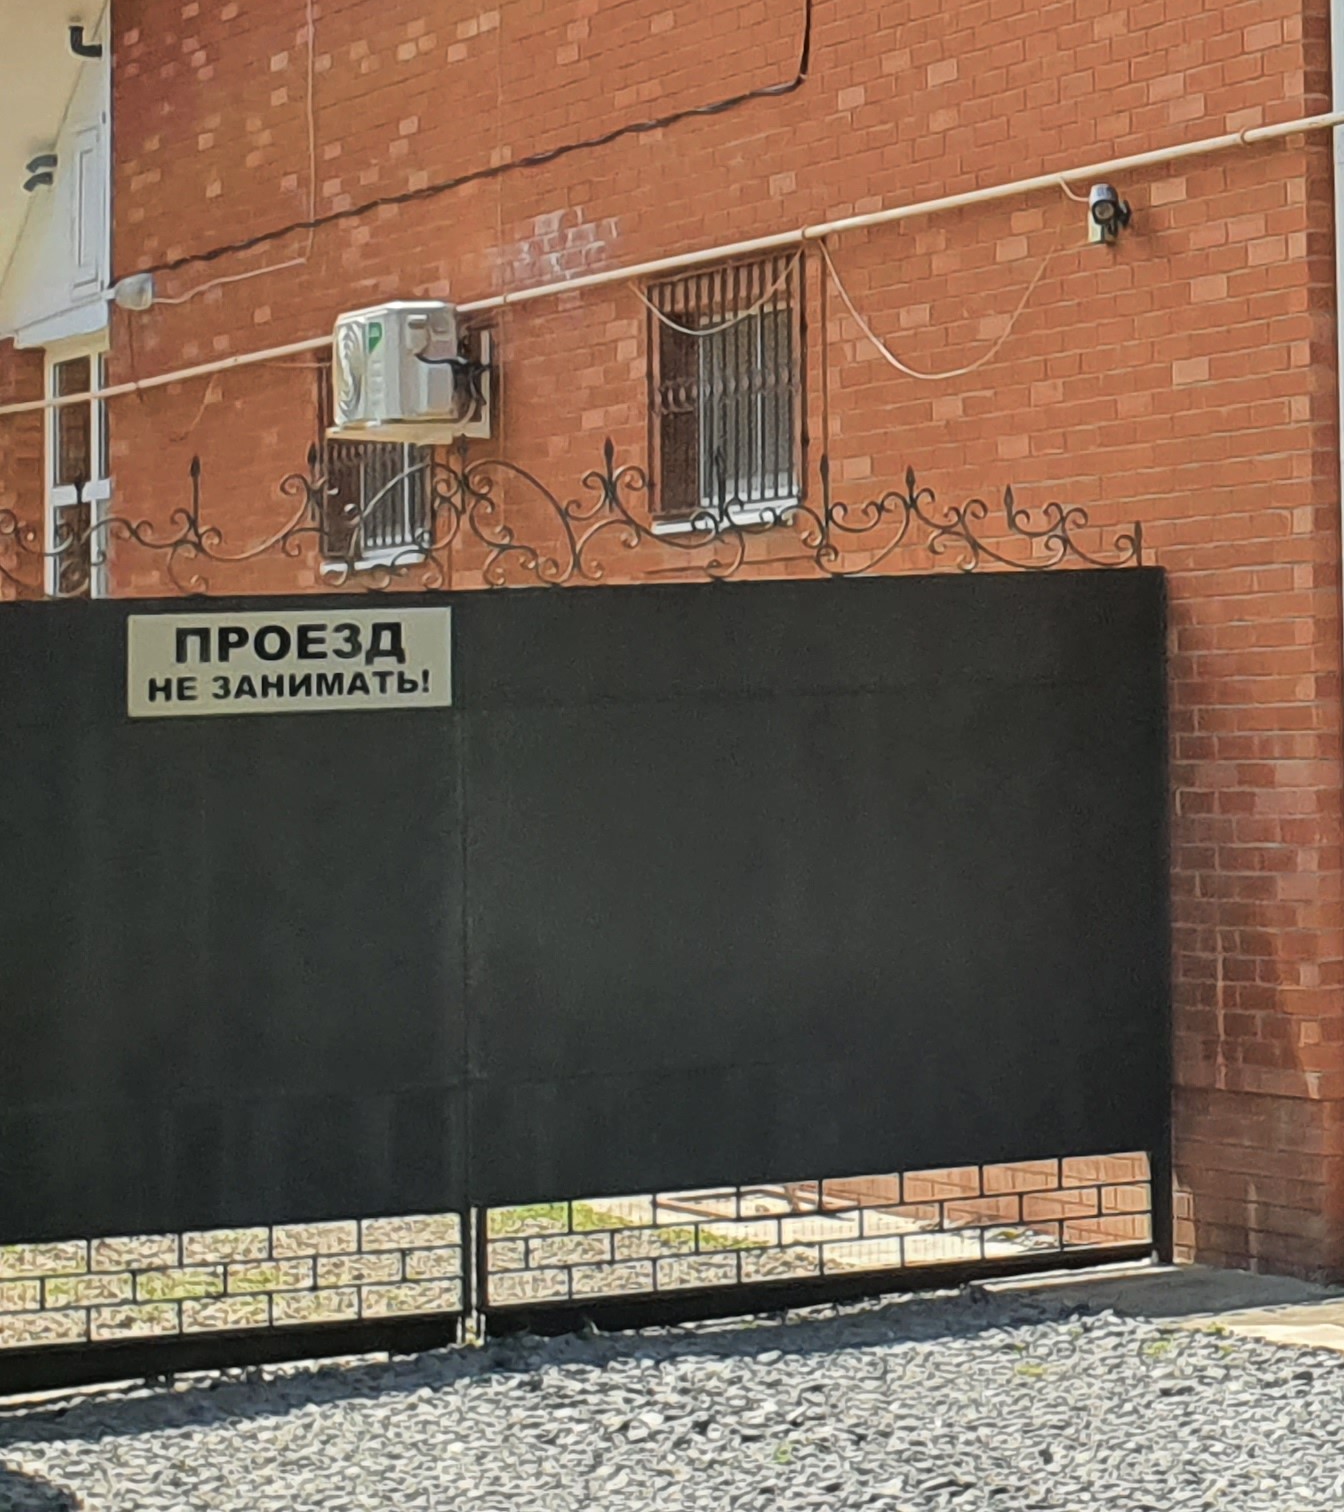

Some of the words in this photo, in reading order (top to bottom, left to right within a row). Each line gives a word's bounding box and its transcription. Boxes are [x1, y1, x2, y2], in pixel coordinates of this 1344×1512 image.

[175, 622, 406, 665] ПРОЕЗД
[148, 675, 198, 702] НЕ
[211, 669, 431, 700] ЗАНИМАТЬ!
